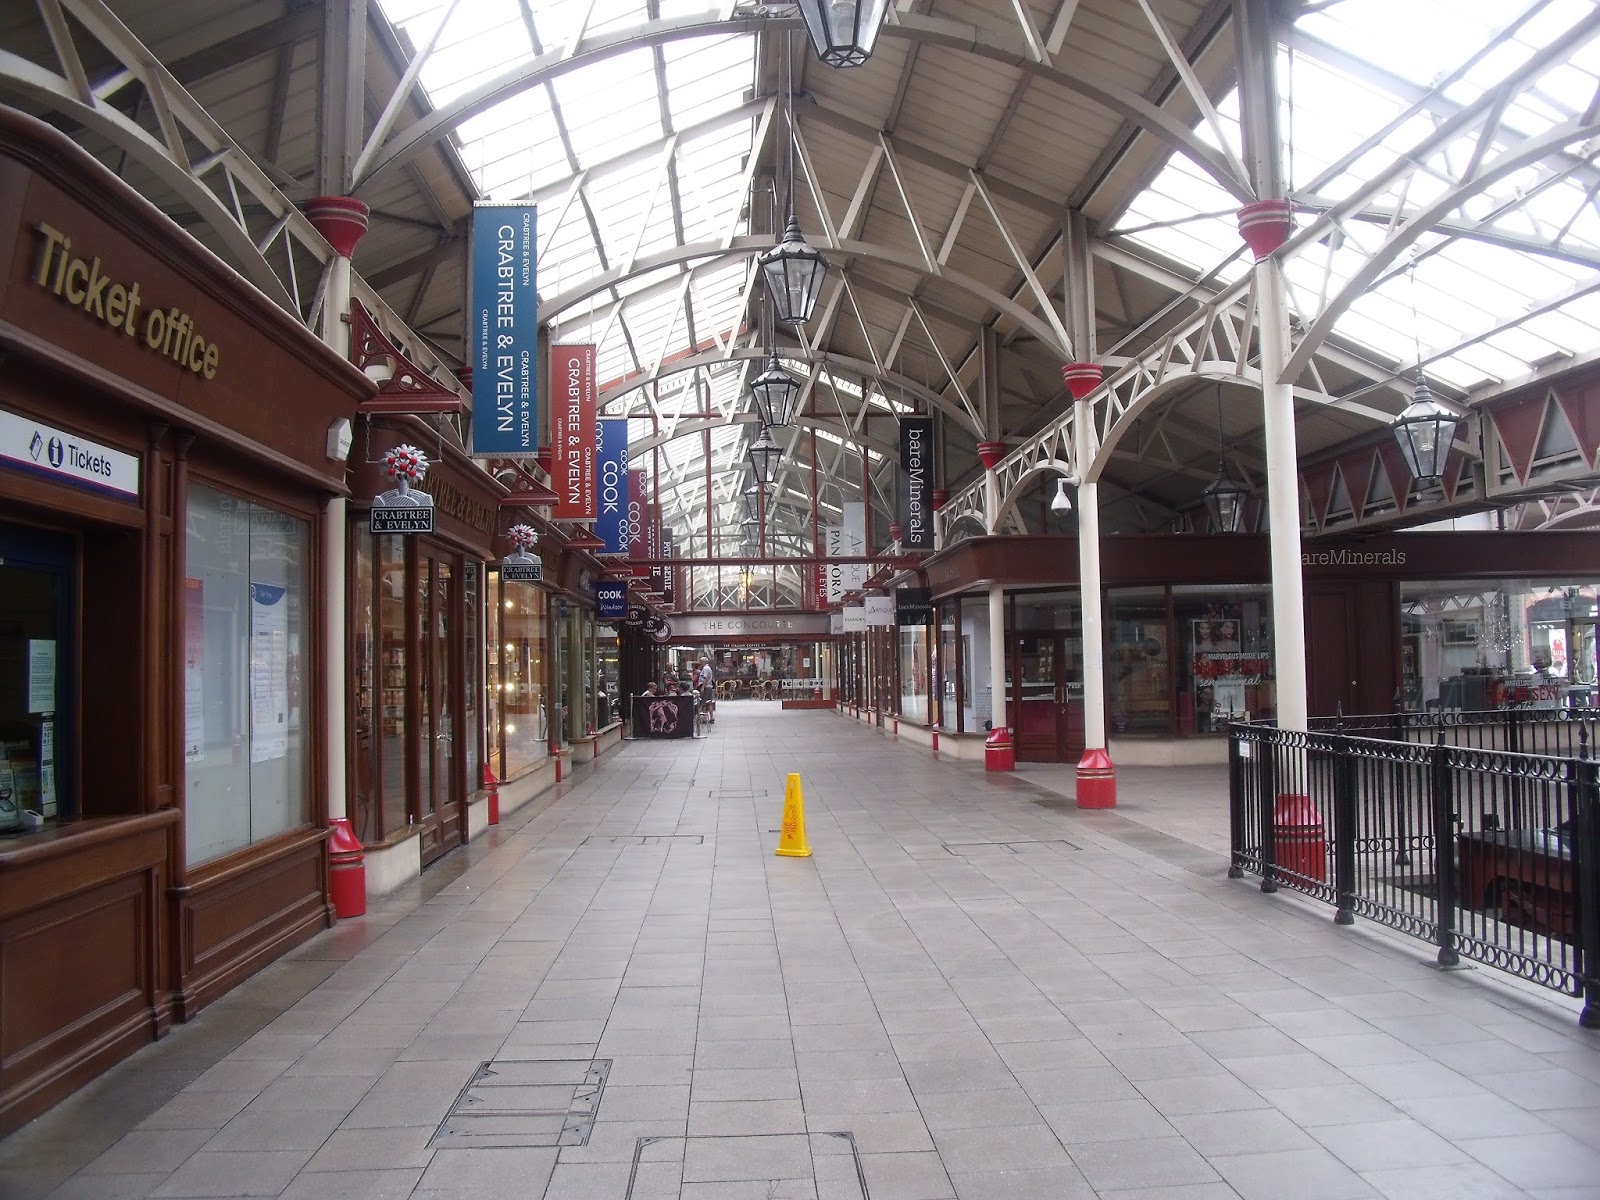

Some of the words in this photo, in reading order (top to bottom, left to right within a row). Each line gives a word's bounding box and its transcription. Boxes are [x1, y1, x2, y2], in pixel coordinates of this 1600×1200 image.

[497, 225, 515, 328] CRABTREE
[37, 222, 141, 336] Ticket
[146, 307, 219, 380] office
[497, 333, 514, 350] &
[521, 350, 529, 399] CRABTREE
[497, 356, 514, 433] EVELYN
[568, 358, 581, 431] CRABTREE
[521, 411, 529, 447] EVELYN
[568, 435, 580, 446] &
[68, 443, 112, 477] Tickets
[568, 450, 580, 504] EVELYN
[620, 449, 628, 476] COOK
[603, 460, 618, 514] COOK
[639, 471, 647, 497] COOK
[909, 428, 924, 543] bareMinerals
[374, 510, 430, 520] CRABTREE
[374, 521, 382, 529] &
[387, 521, 429, 529] EVELYN
[628, 501, 641, 544] COOK
[619, 519, 628, 551] COOK
[831, 530, 841, 597] PANORA
[1301, 549, 1406, 565] areMinerals
[598, 590, 622, 599] COOK
[703, 621, 723, 630] THE
[727, 620, 793, 630] CONCOURSE
[1207, 652, 1239, 660] MARVELOUS
